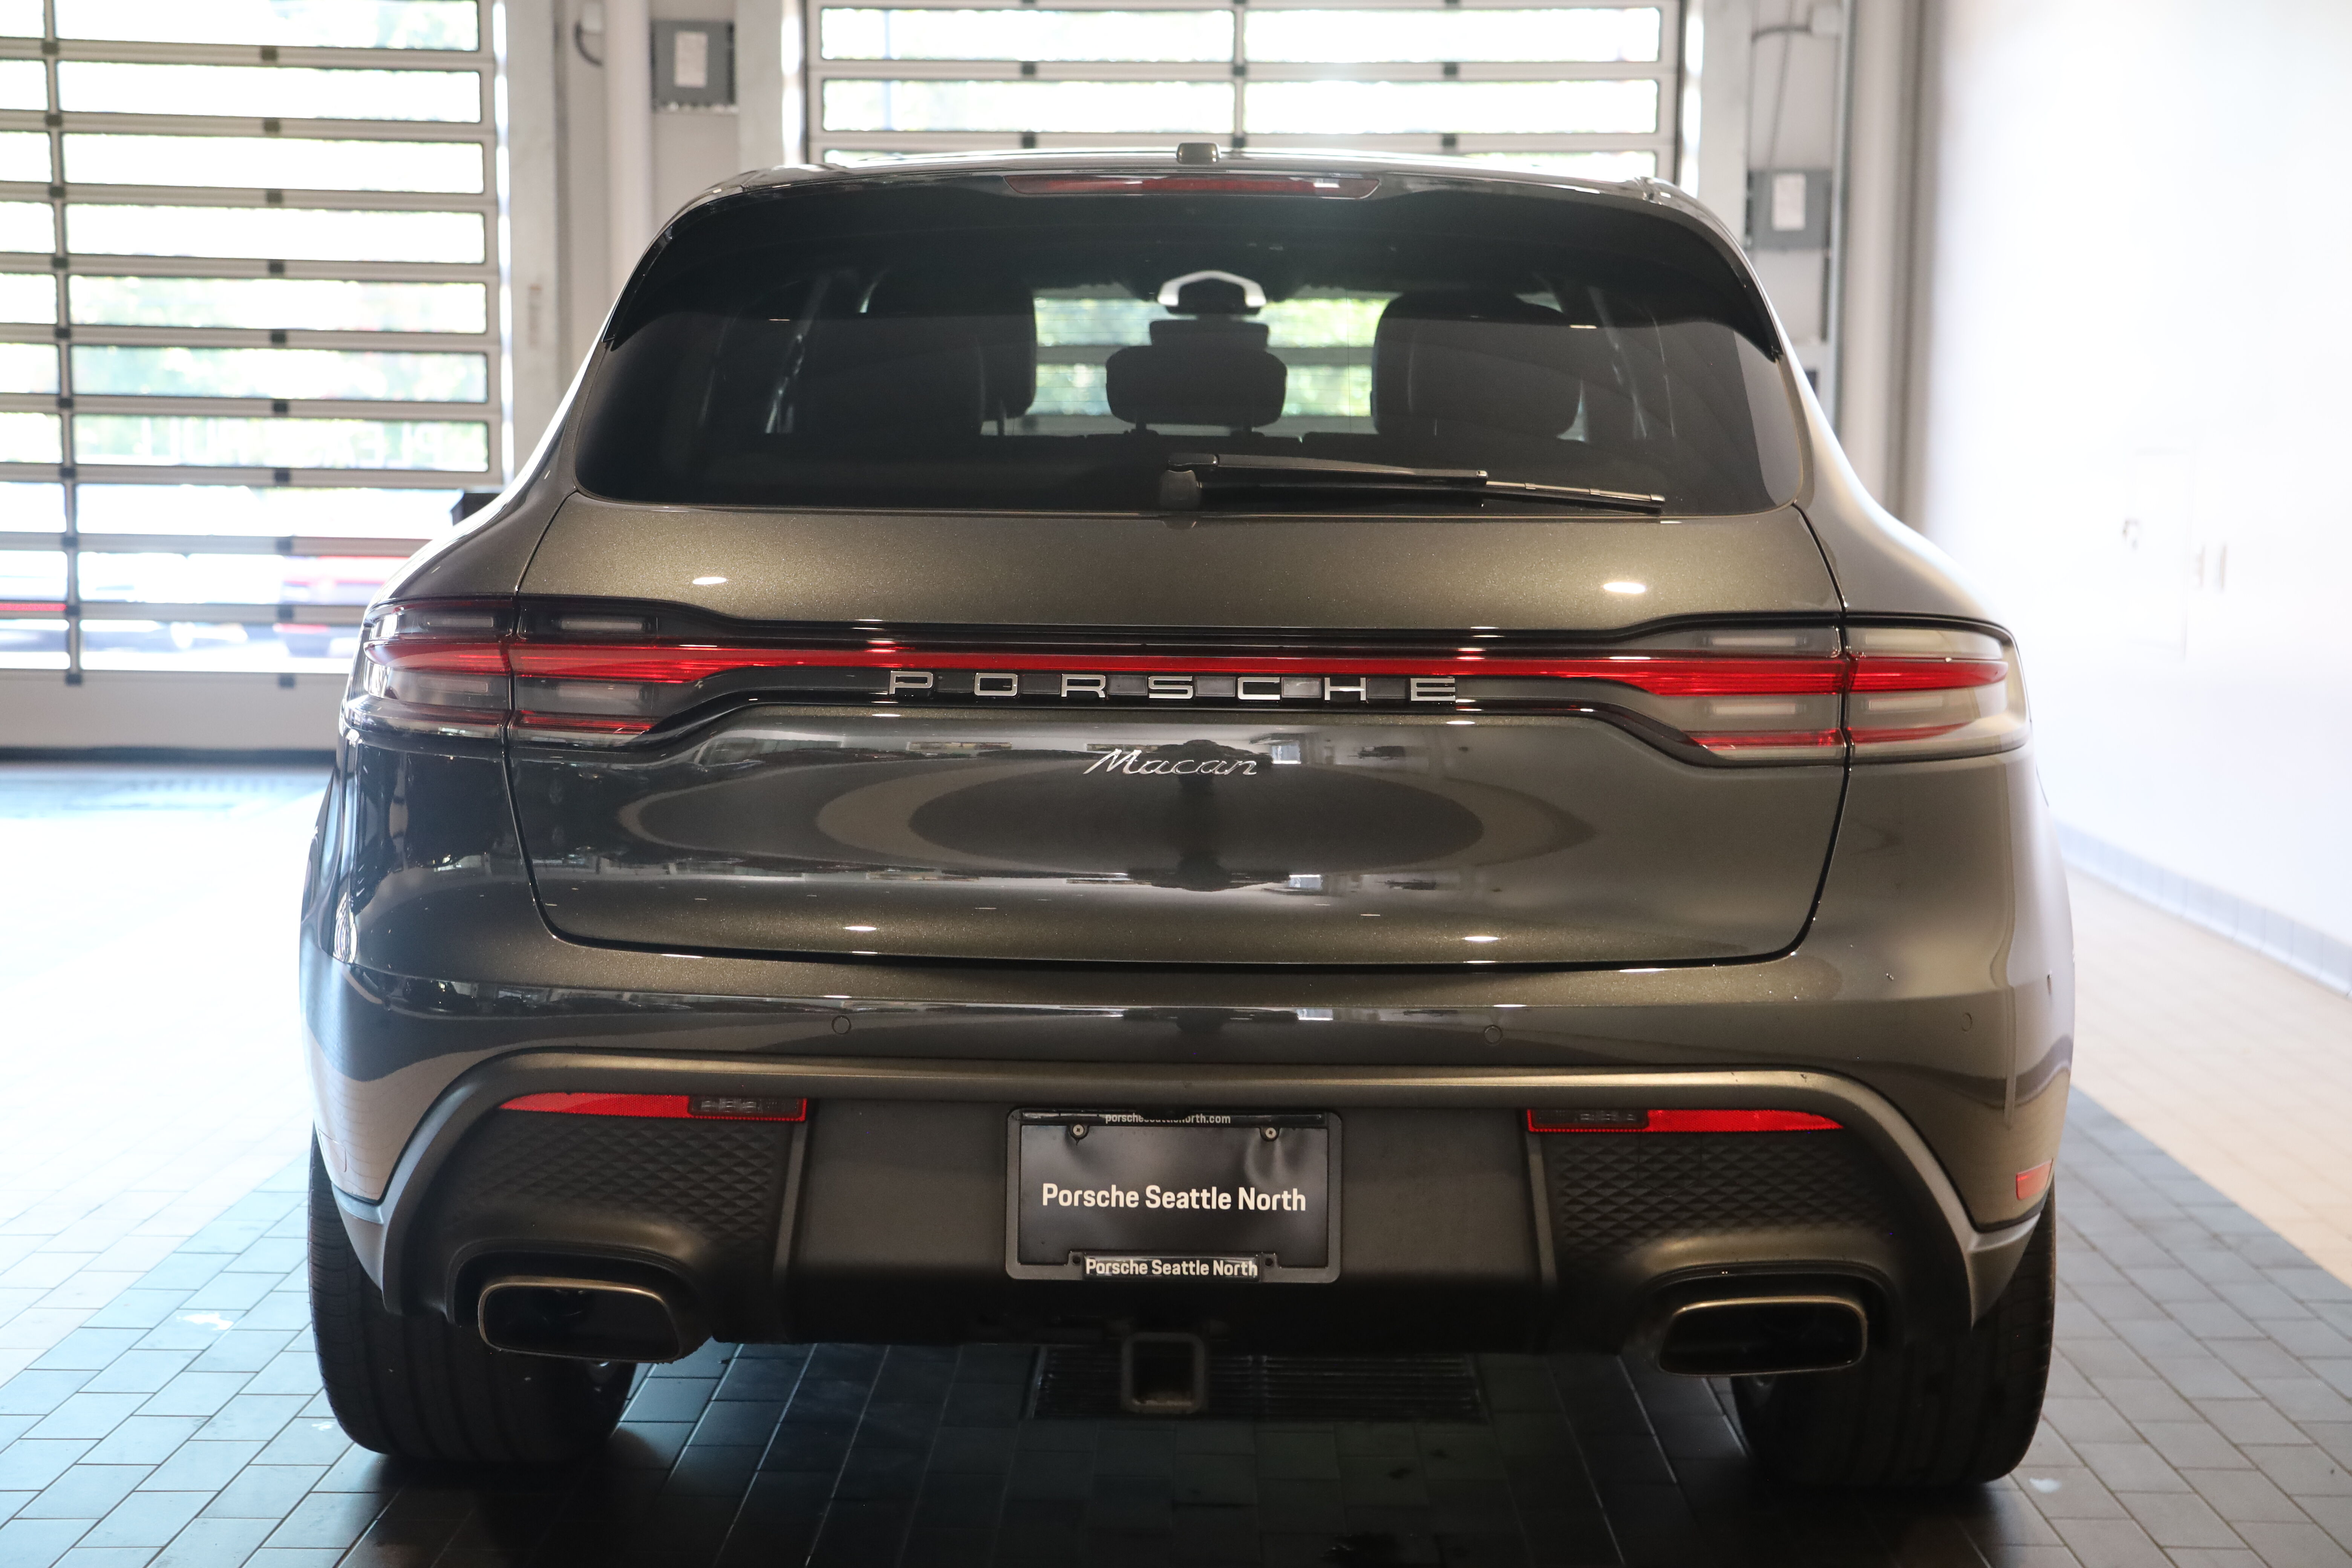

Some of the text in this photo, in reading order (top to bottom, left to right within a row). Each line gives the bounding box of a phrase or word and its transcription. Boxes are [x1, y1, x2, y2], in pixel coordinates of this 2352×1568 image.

[888, 671, 1456, 701] PORSCHE
[1083, 748, 1258, 775] Macan
[1043, 1183, 1306, 1211] Porsche Seattle North
[1086, 1258, 1258, 1276] Porsche Seattle North
